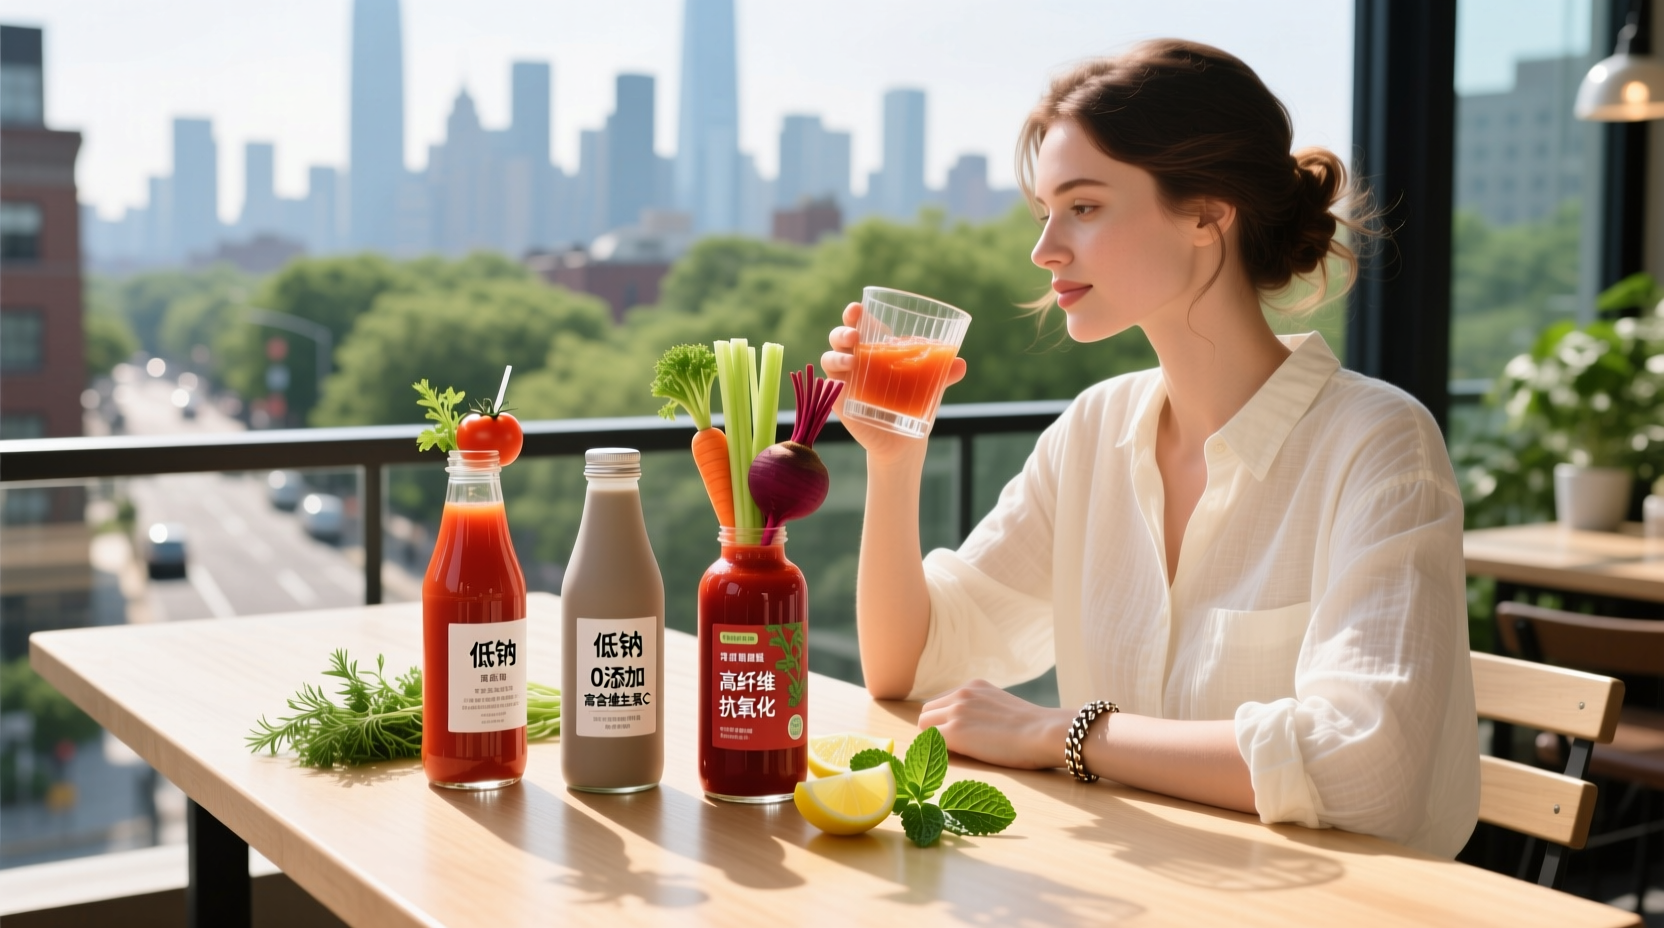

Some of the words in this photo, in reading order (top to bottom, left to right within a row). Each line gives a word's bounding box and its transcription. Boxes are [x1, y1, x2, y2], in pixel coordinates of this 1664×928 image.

[470, 639, 516, 668] 低钠
[594, 631, 642, 658] 低钠
[591, 666, 644, 688] 0添加
[719, 670, 776, 692] 高纤维
[718, 695, 775, 718] 抗氧化
